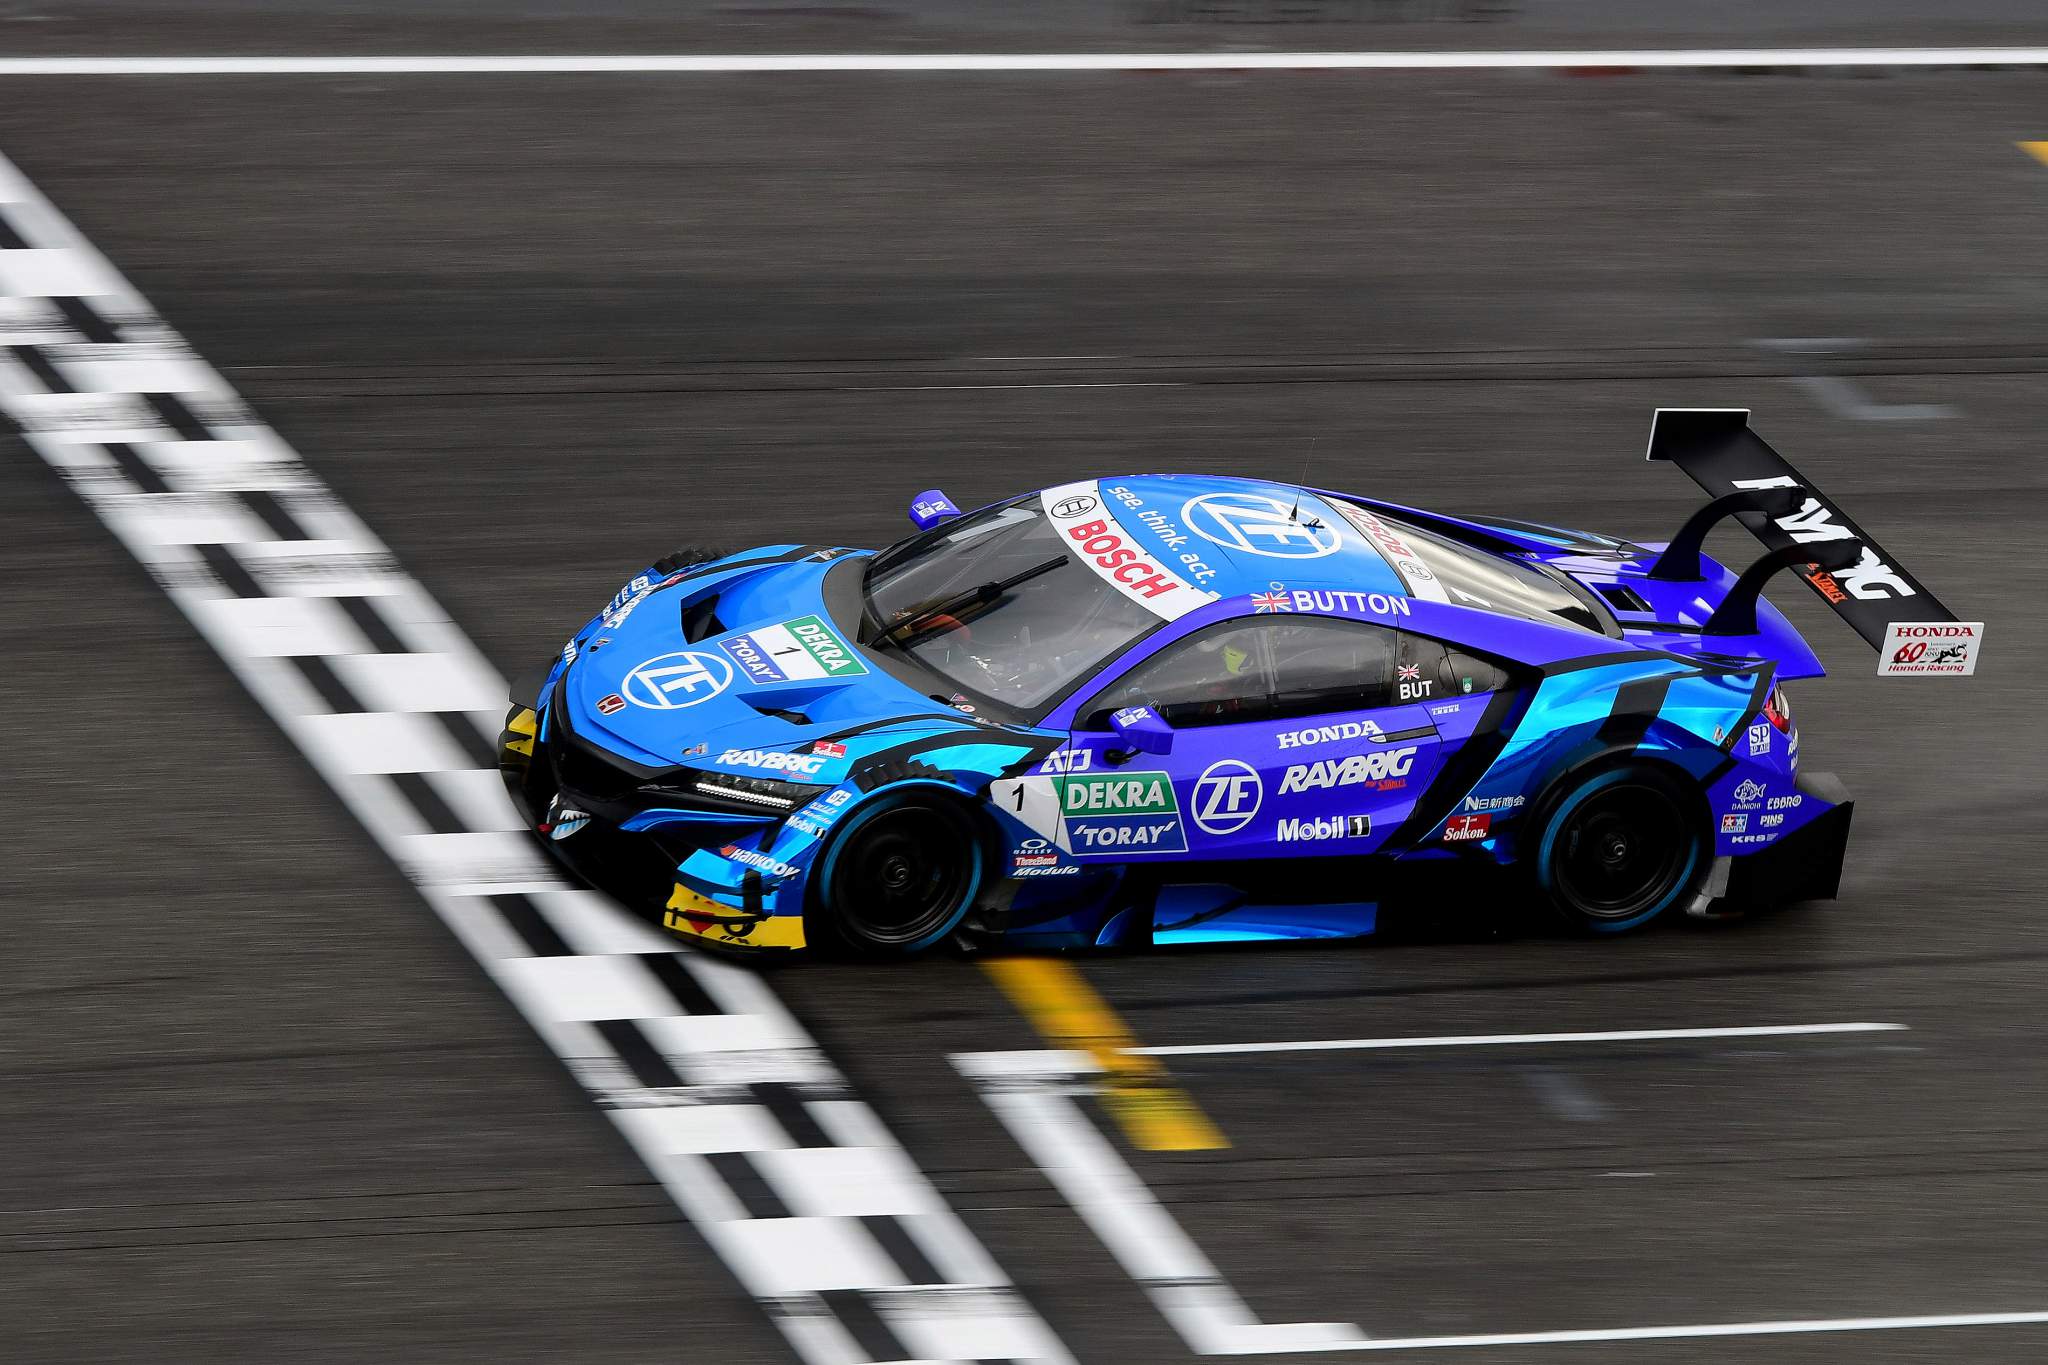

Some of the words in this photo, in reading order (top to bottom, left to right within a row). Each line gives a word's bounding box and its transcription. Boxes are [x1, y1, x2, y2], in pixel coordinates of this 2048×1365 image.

[1193, 499, 1332, 553] ZF
[1067, 519, 1180, 599] BOSCH
[1291, 589, 1411, 616] BUTTON
[1897, 626, 1974, 638] HONDA
[774, 646, 802, 656] 1
[793, 623, 852, 671] DEKRA
[1893, 642, 1927, 663] 60
[632, 653, 722, 708] ZF
[1888, 664, 1924, 673] Honda
[1926, 664, 1965, 673] Racing
[1400, 680, 1432, 700] BUT
[1276, 719, 1384, 750] HONDA
[715, 749, 828, 774] RAYBRIG
[1277, 746, 1418, 795] RAYBRIG
[1012, 783, 1025, 812] 1
[1066, 780, 1166, 810] DEKRA
[1197, 773, 1260, 823] ZF
[1277, 815, 1344, 842] Mobil
[1351, 816, 1366, 836] 1
[1012, 865, 1080, 876] Modulo
